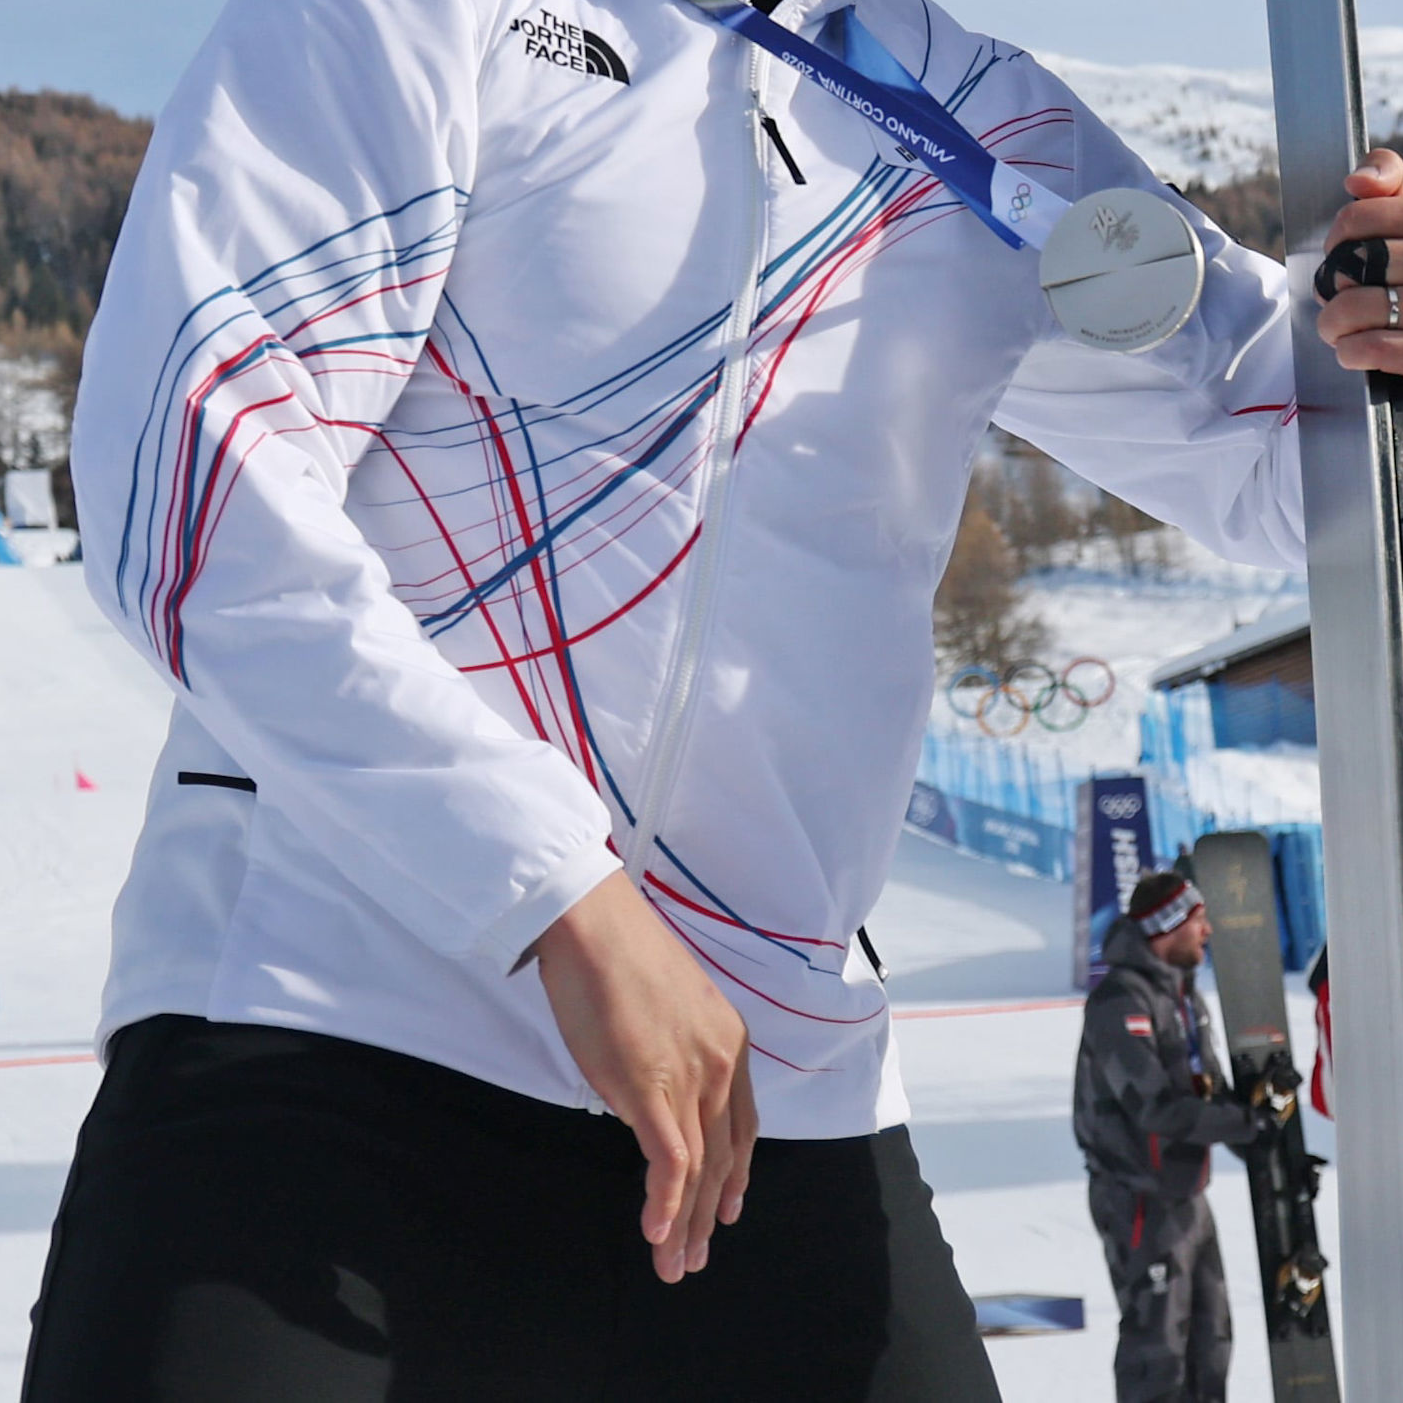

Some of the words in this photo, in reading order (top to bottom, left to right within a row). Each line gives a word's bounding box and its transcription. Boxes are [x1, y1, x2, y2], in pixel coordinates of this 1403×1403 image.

[540, 9, 580, 39] THE
[525, 39, 585, 72] FACE
[781, 51, 815, 78] 2026
[817, 71, 884, 123] CORTINA
[886, 116, 956, 163] MILANO
[1110, 827, 1140, 915] NISH
